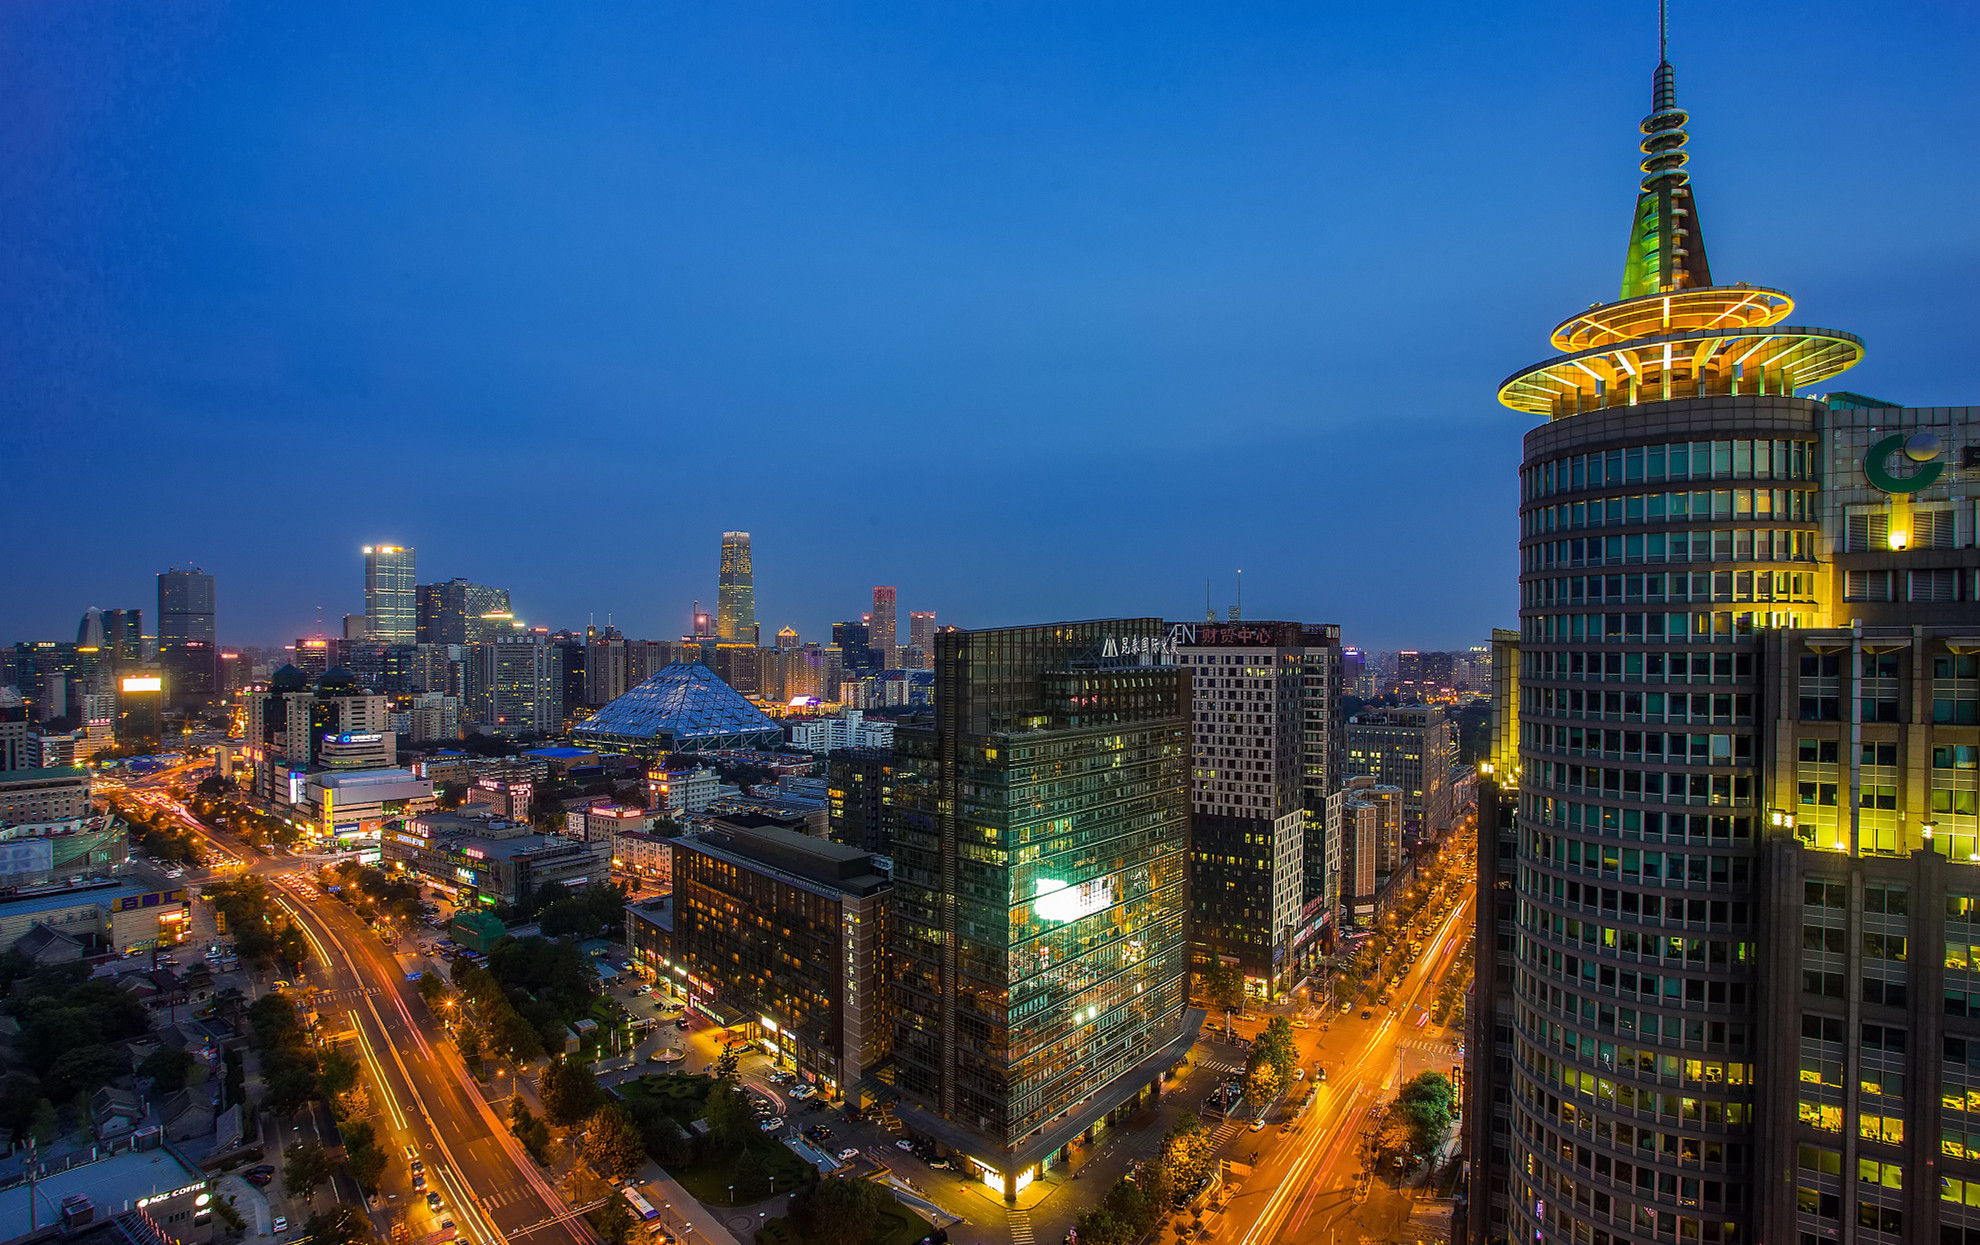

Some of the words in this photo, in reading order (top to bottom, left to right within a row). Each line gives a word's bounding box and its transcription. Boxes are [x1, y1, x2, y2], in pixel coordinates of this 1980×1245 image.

[1202, 628, 1271, 644] 财贸中心
[1121, 634, 1179, 655] 昆泰国际大厦
[171, 1182, 206, 1197] COFFEE
